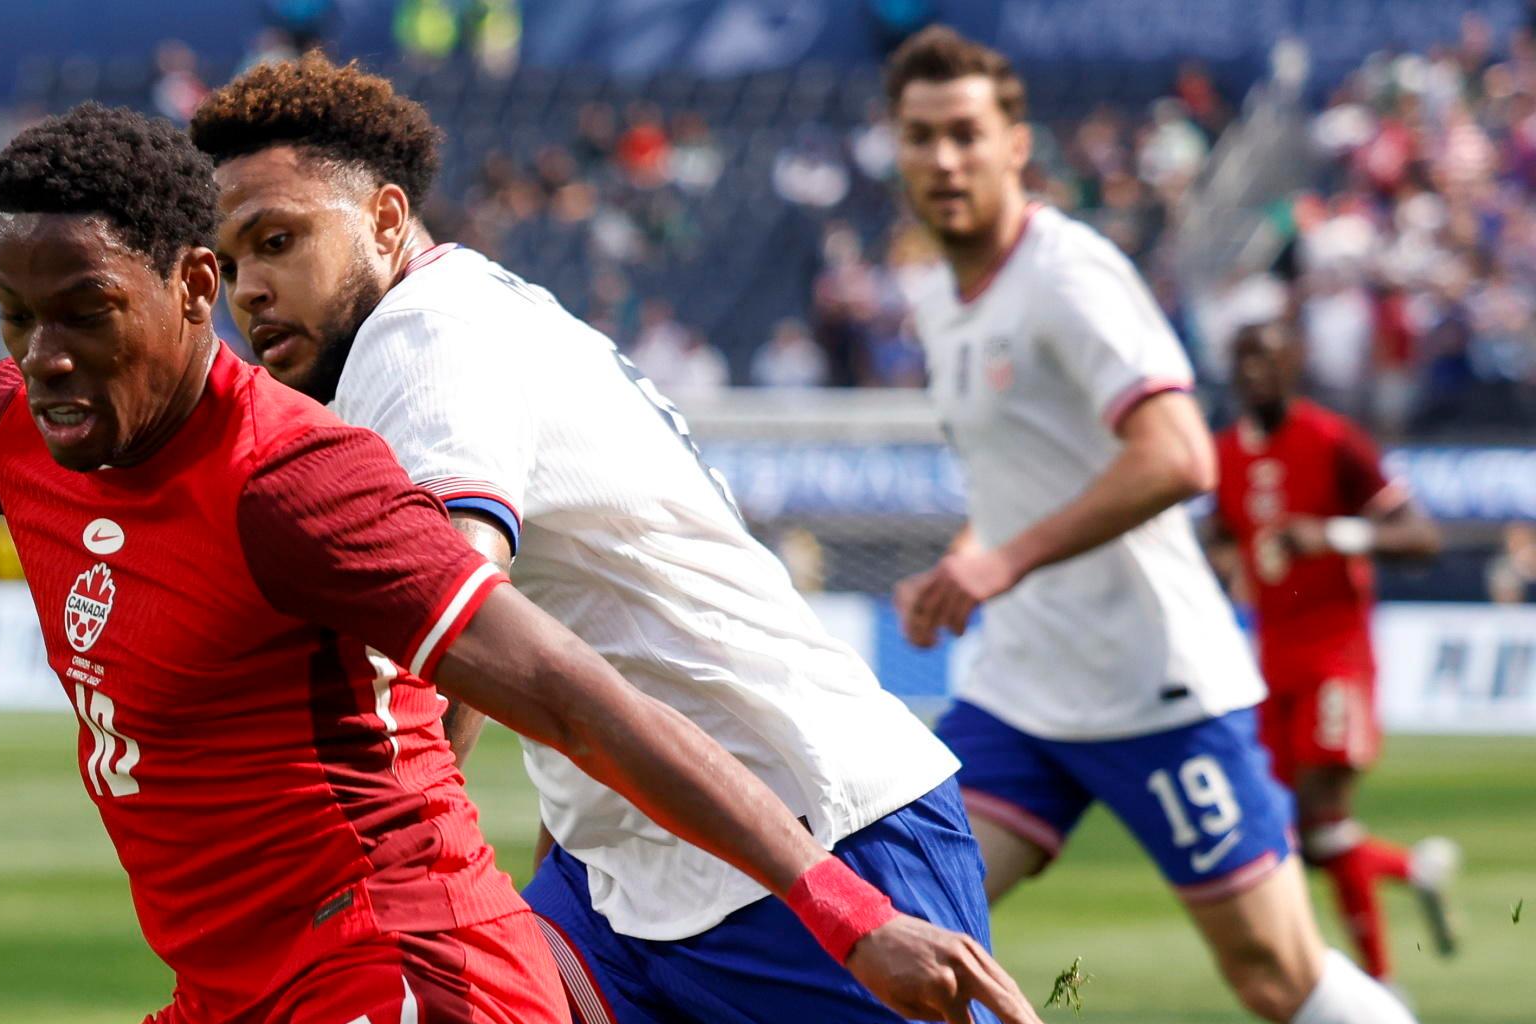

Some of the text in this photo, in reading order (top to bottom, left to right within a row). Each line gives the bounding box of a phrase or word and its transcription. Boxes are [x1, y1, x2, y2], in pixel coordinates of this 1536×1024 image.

[68, 595, 106, 620] CANADA
[75, 682, 140, 797] 10
[1147, 754, 1242, 847] 19
